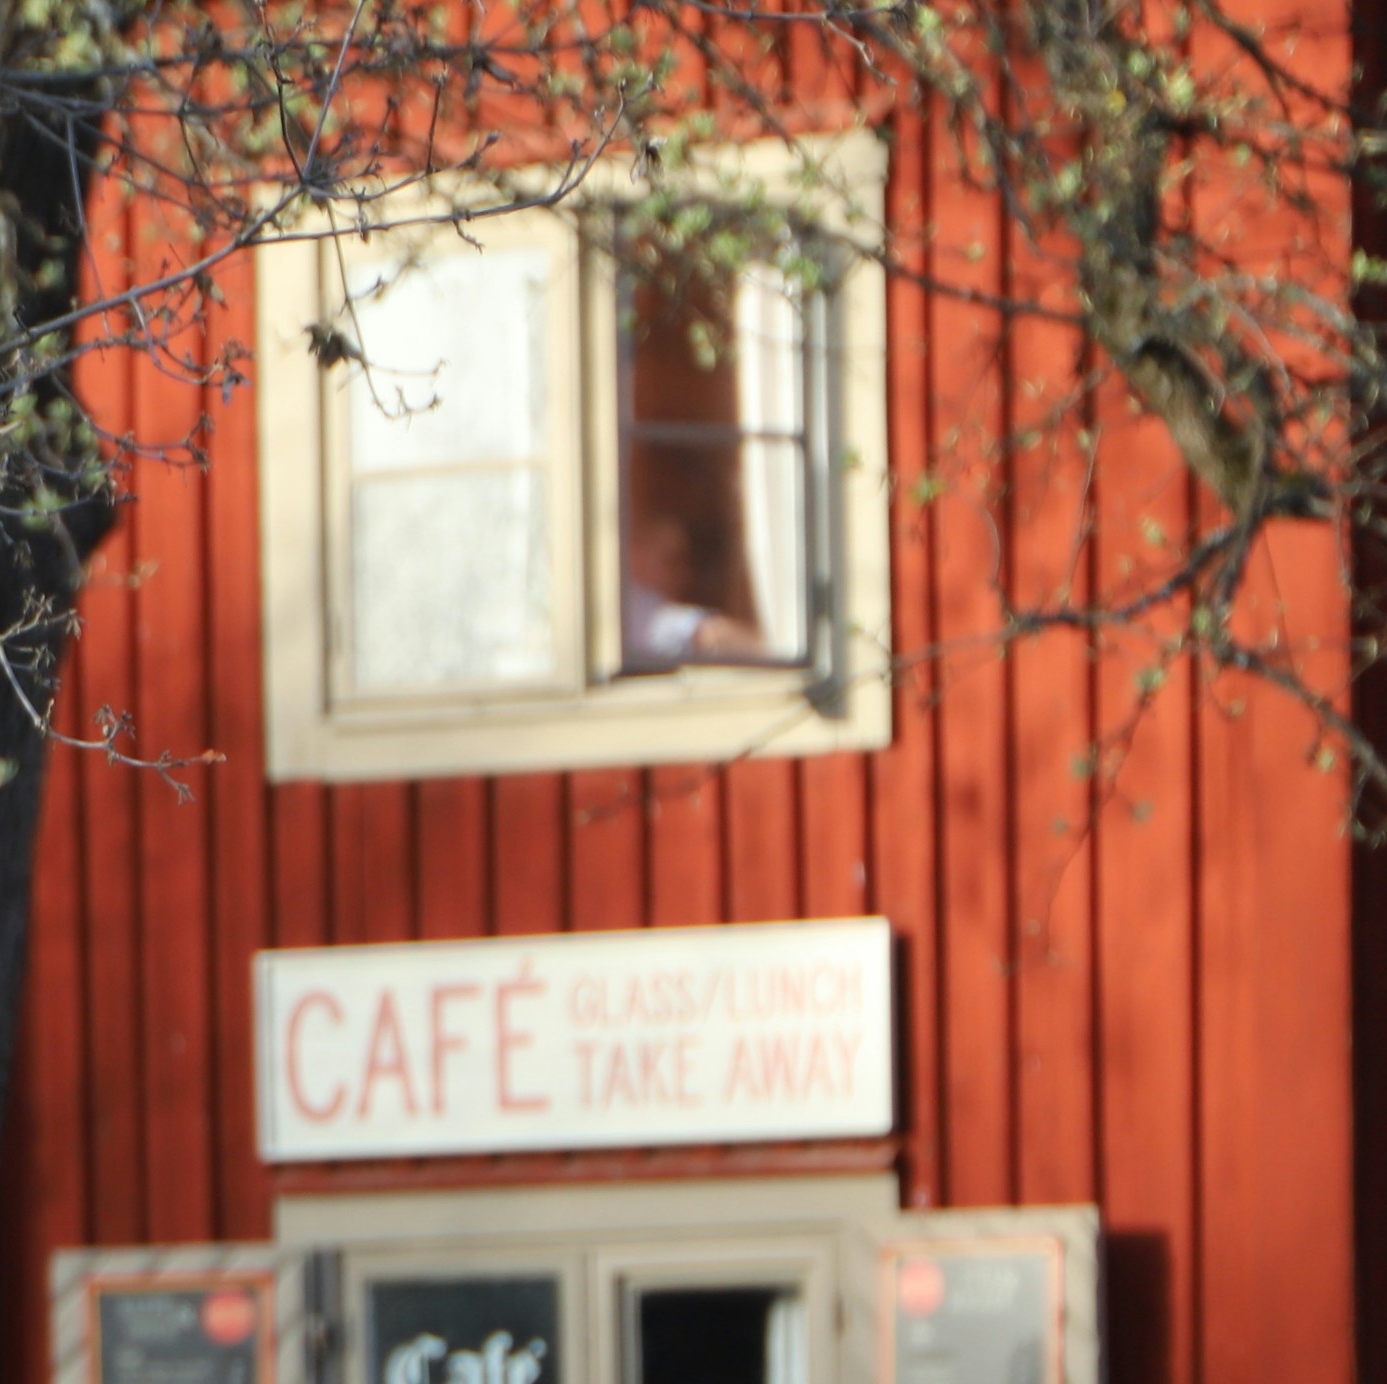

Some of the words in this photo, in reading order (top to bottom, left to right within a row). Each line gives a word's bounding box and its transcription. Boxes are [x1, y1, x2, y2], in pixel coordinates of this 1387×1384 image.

[567, 958, 863, 1029] GLASS/LUNCH
[284, 955, 550, 1124] CAFÉ
[570, 1033, 704, 1111] TAKE
[721, 1024, 864, 1105] AWAY
